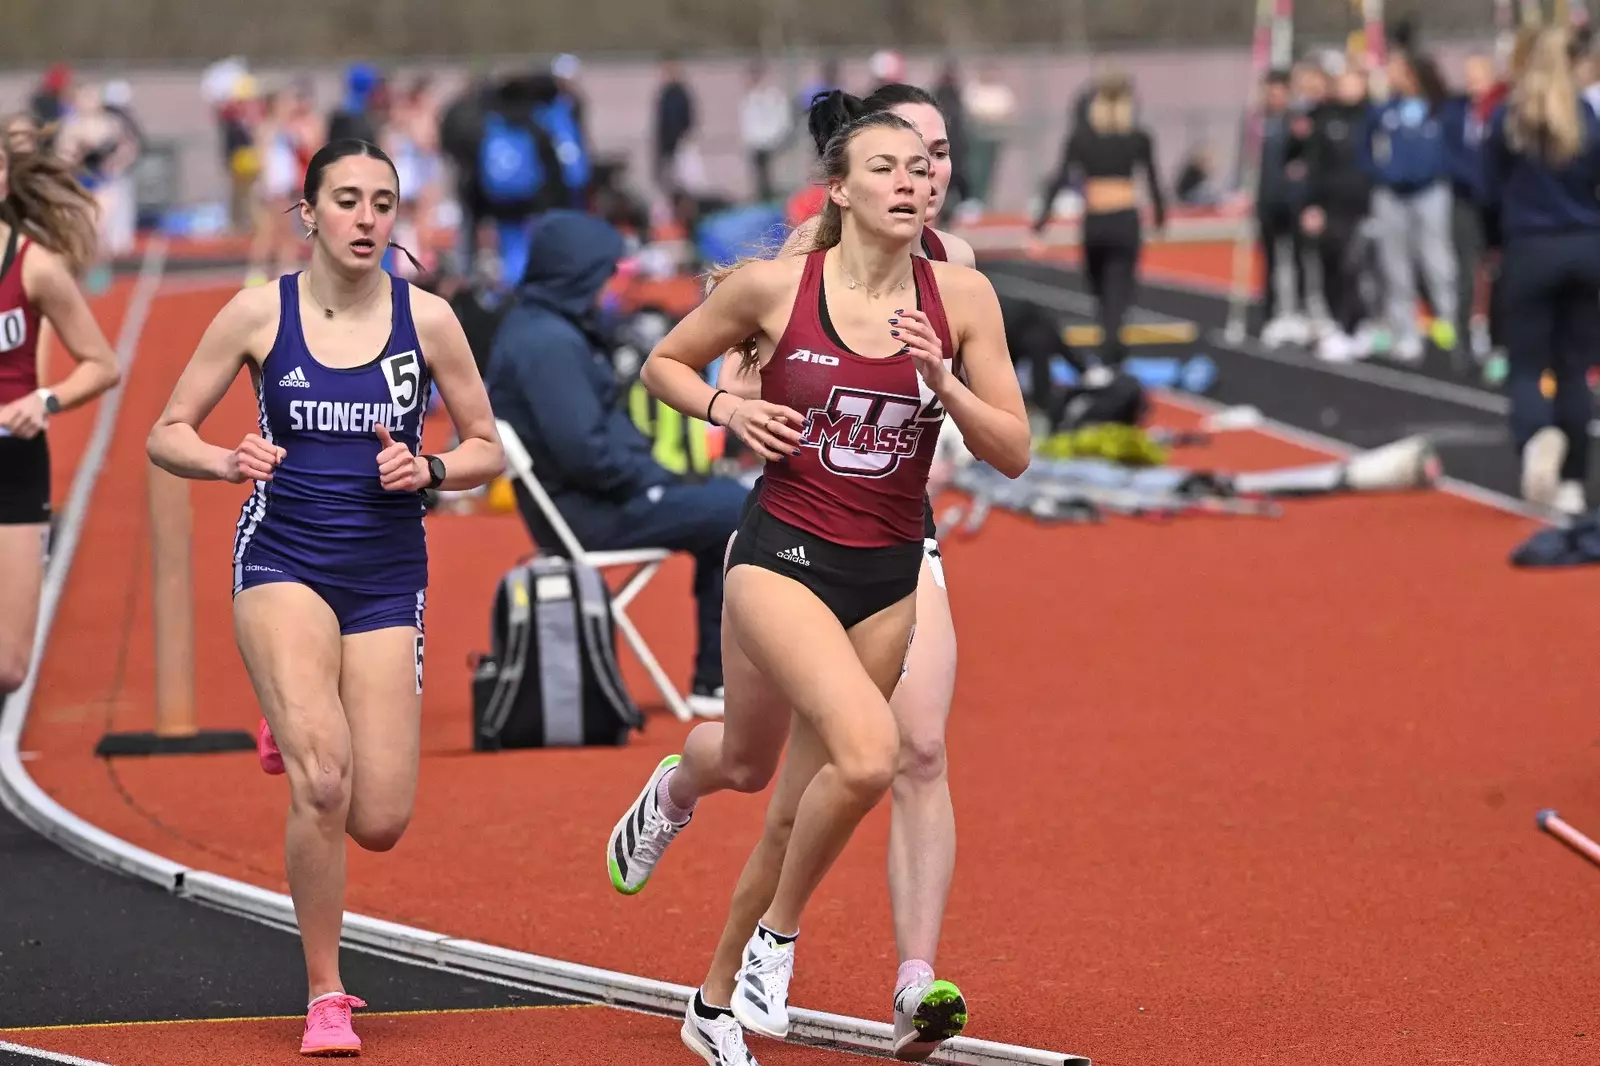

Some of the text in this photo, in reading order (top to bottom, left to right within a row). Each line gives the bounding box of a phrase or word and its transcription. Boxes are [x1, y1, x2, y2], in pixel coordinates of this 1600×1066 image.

[786, 349, 839, 366] A10
[279, 379, 310, 388] adidas
[390, 354, 417, 408] 5
[777, 551, 810, 567] adidas
